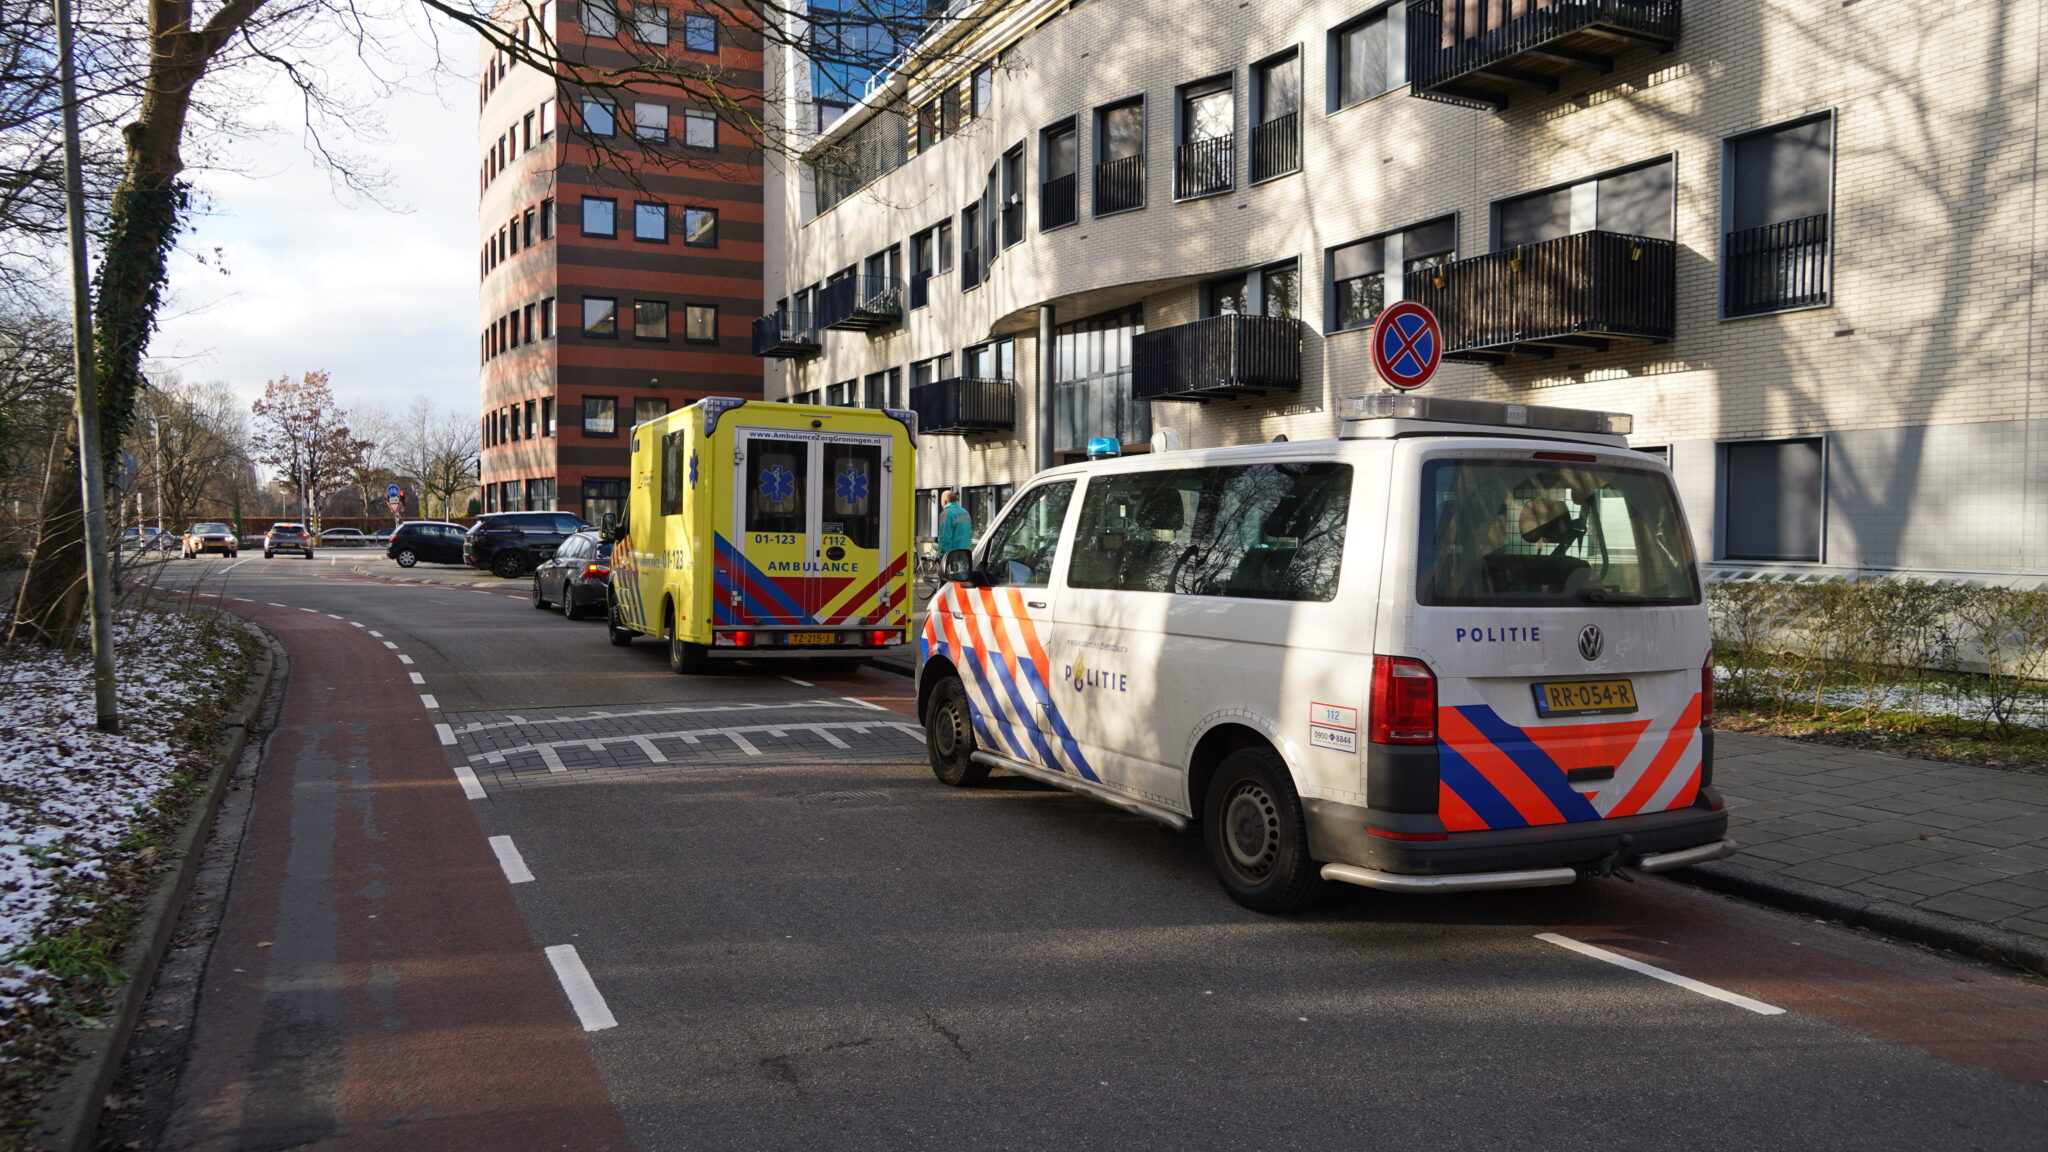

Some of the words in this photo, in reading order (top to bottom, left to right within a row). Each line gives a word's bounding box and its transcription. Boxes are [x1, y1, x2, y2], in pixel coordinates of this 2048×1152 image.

[749, 431, 881, 444] www.AmbulanceZorgGroningen.nl
[755, 534, 796, 544] 01-123
[662, 550, 684, 570] 01-123
[768, 562, 858, 572] AMBULANCE
[793, 632, 830, 643] TZ-215-J
[1456, 627, 1540, 642] POLITIE
[1065, 664, 1127, 692] POLITIE
[1550, 684, 1631, 707] RR-054-R
[1327, 709, 1340, 720] 112
[1336, 735, 1351, 744] 8844
